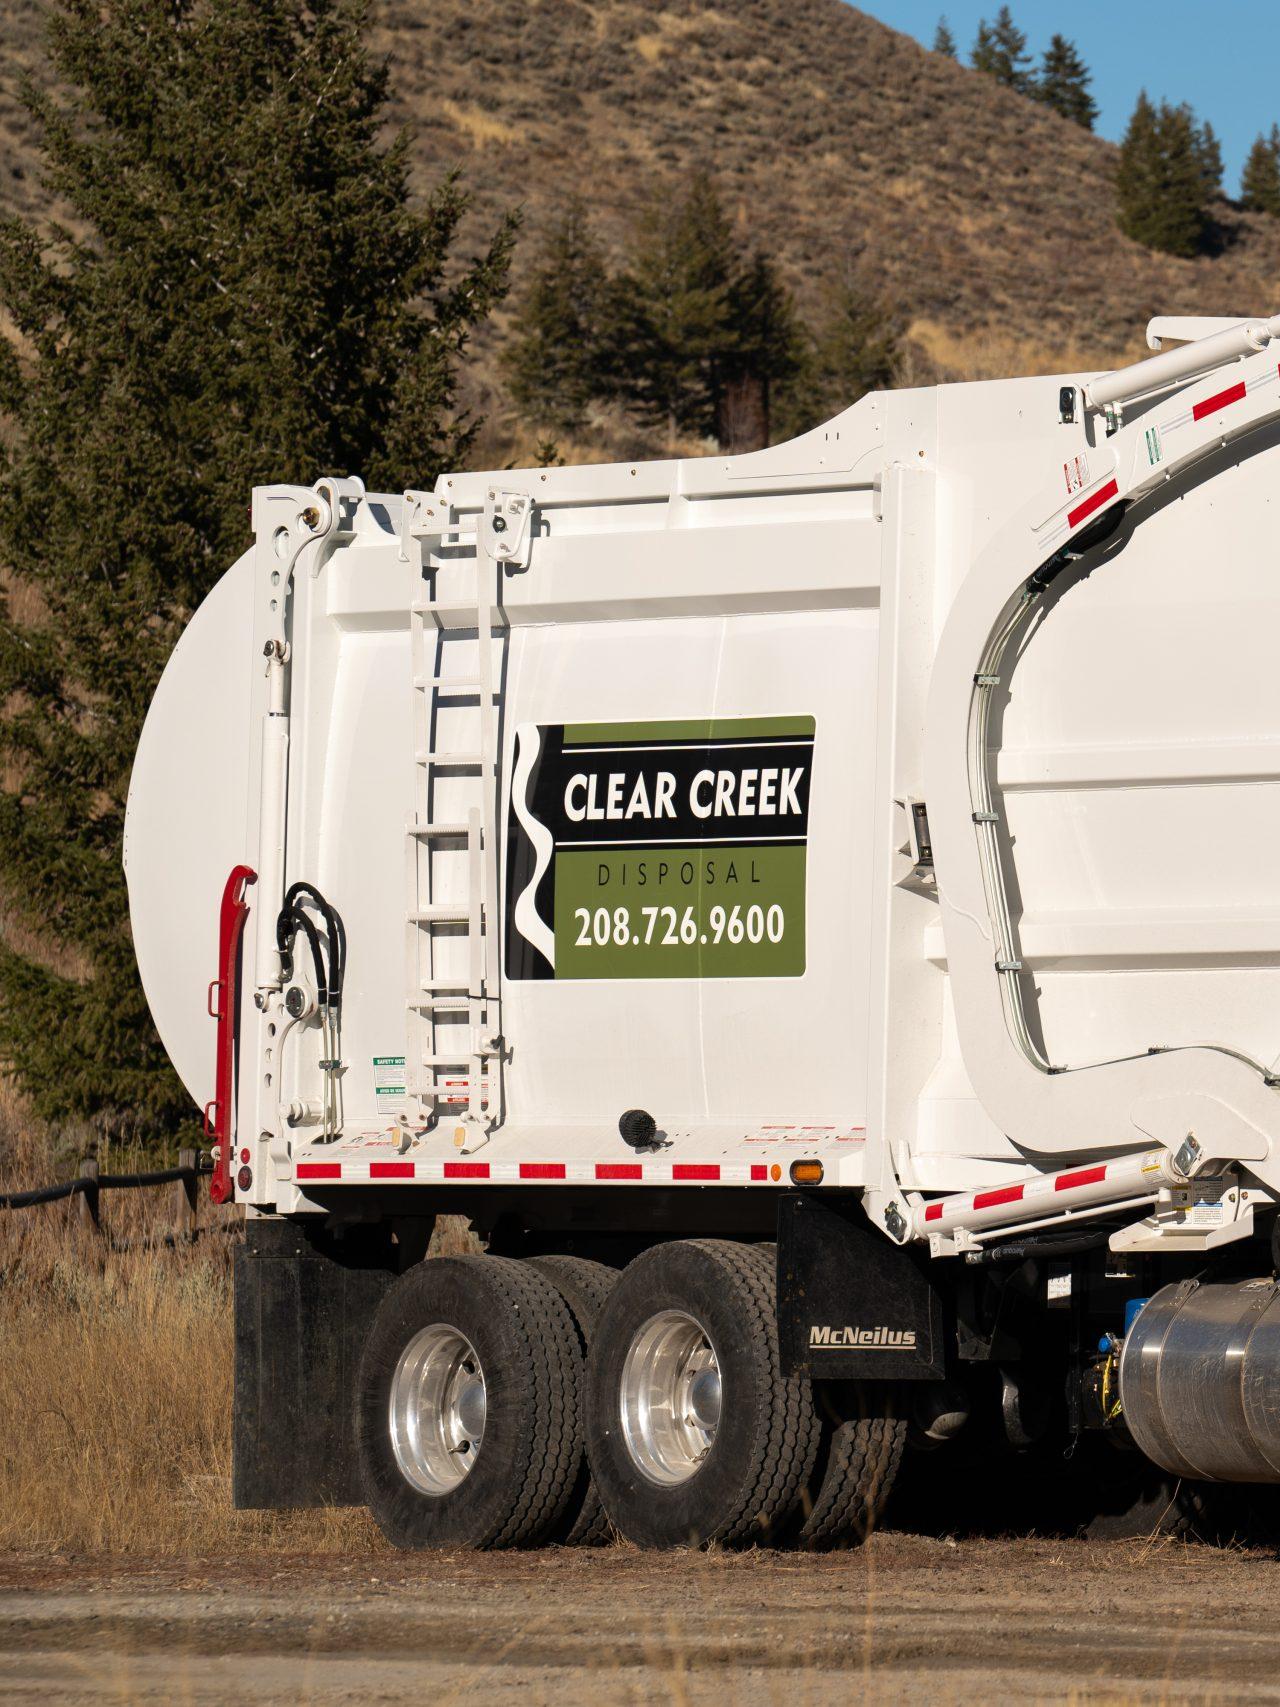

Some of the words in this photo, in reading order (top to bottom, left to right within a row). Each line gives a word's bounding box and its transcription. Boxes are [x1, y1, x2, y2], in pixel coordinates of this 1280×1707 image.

[563, 771, 678, 822] CLEAR
[689, 767, 805, 819] CREEK
[597, 860, 761, 887] DISPOSAL
[574, 904, 785, 947] 208.726.9600
[809, 1325, 916, 1345] McNeilus
